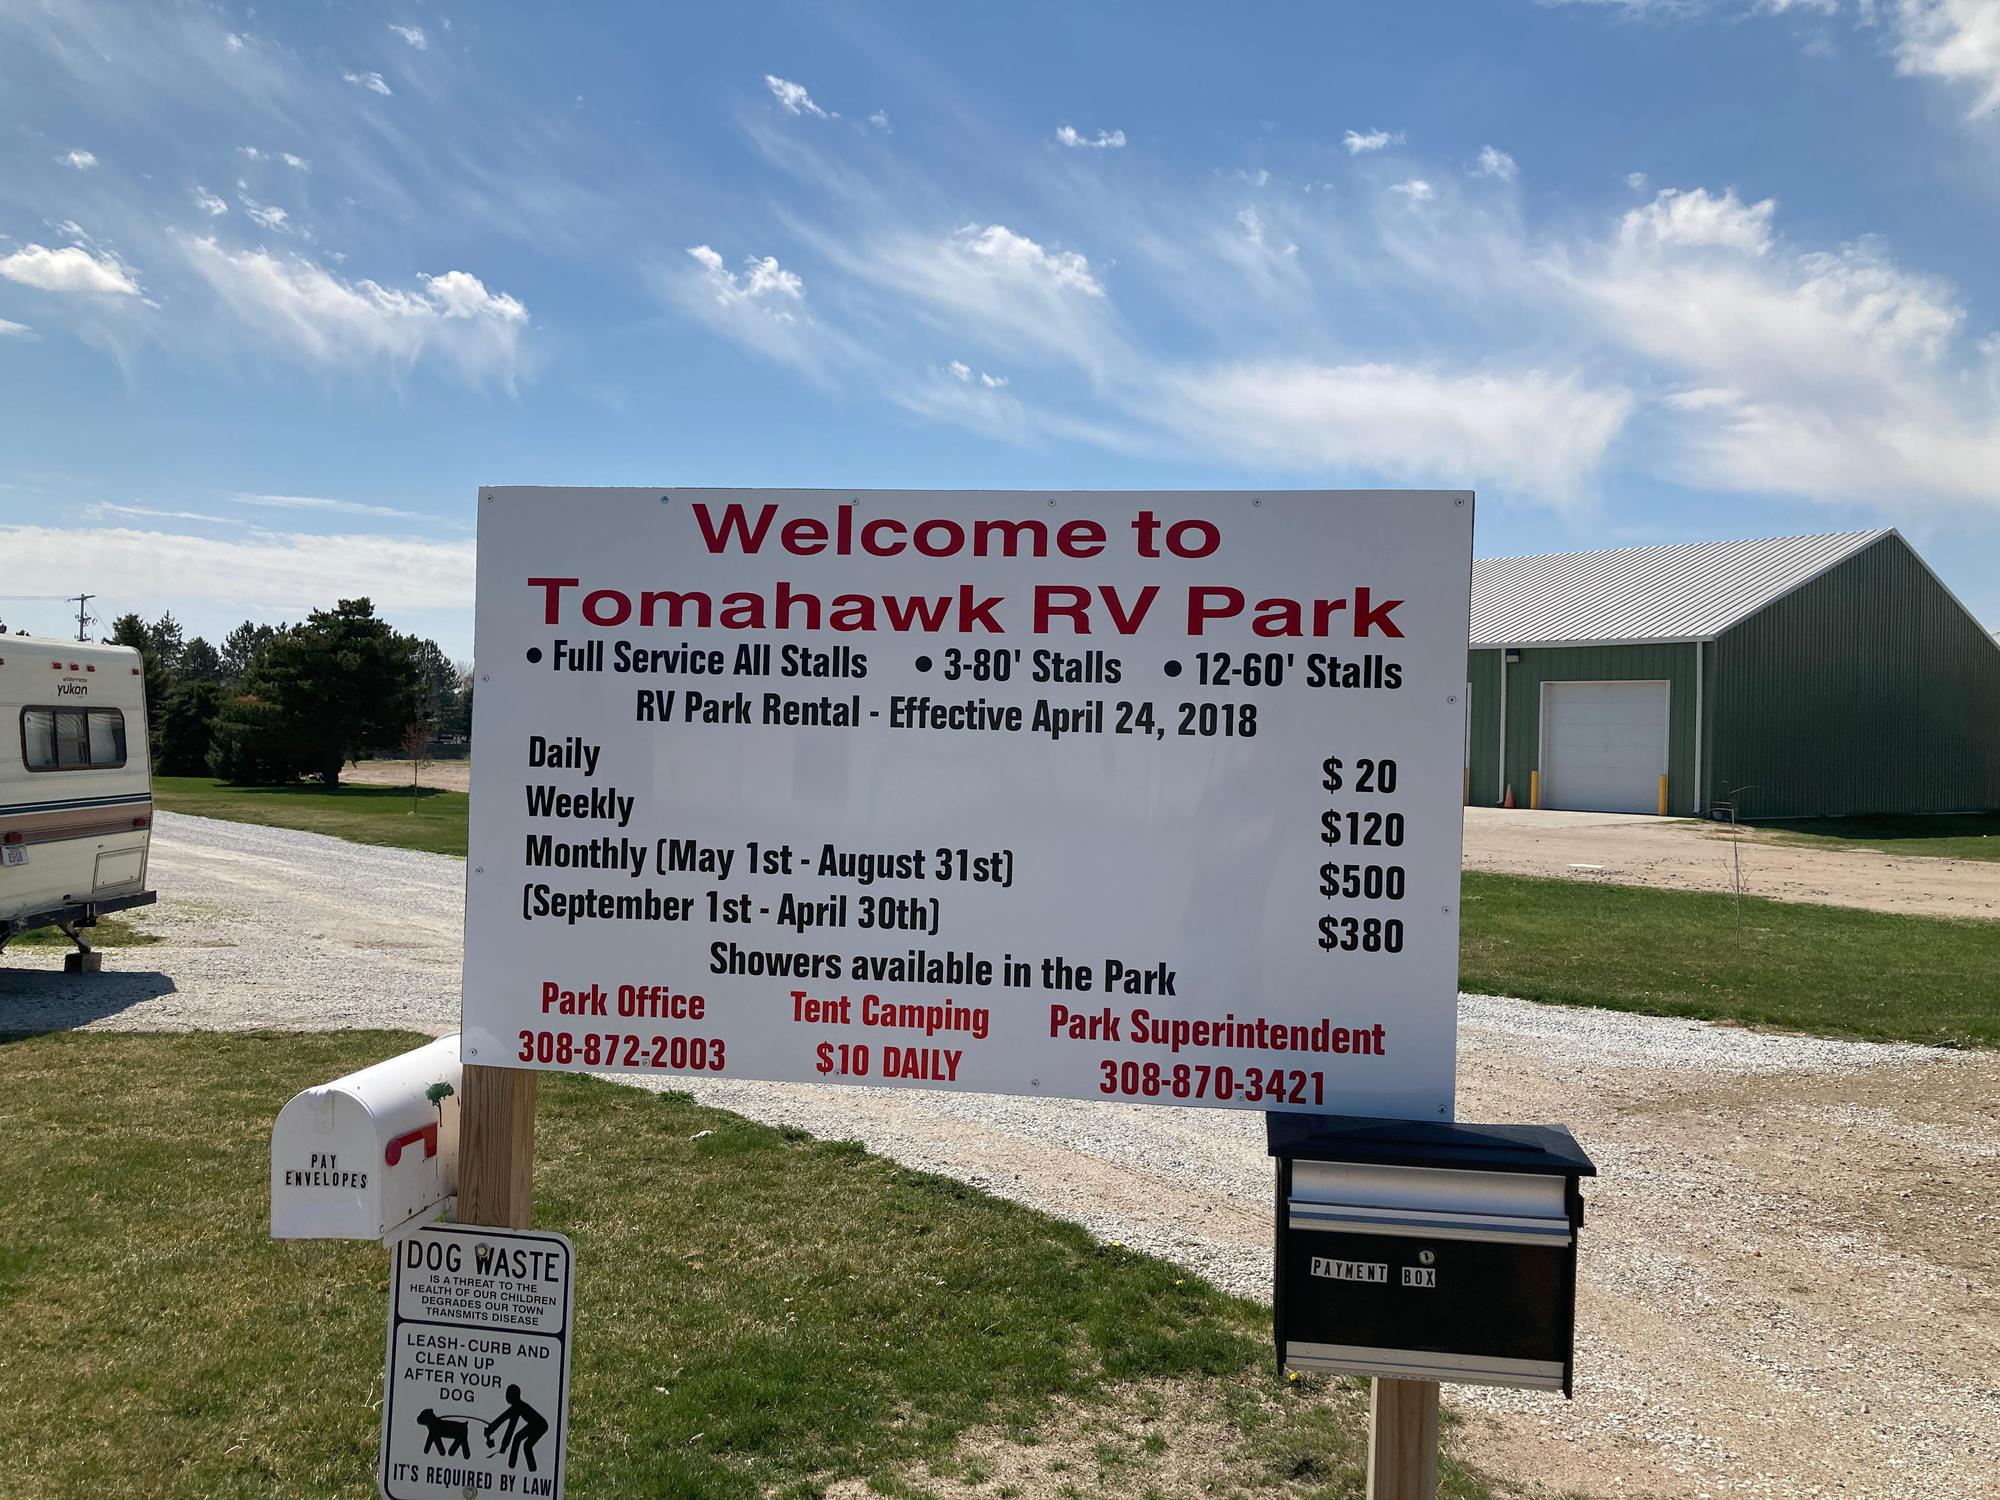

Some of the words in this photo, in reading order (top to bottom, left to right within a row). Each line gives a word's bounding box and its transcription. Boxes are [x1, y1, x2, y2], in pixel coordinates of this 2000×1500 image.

[692, 504, 1106, 558] Welcome
[1132, 511, 1220, 558] to
[528, 578, 1005, 633] Tomahawk
[1034, 586, 1160, 634] RV
[1188, 587, 1405, 638] Park
[554, 640, 603, 671] Full
[614, 641, 724, 674] Service
[733, 644, 770, 675] All
[781, 644, 867, 678] Stalls
[945, 648, 1020, 681] 3-80'
[1033, 649, 1121, 683] Stalls
[1196, 653, 1294, 686] 12-60'
[1307, 654, 1402, 689] Stalls
[58, 683, 88, 696] yukon
[637, 690, 675, 721] RV
[685, 691, 751, 724] Park
[763, 693, 859, 726] Rental
[890, 696, 1022, 731] Effective
[1032, 700, 1103, 740] April
[1116, 701, 1164, 740] 24,
[1178, 703, 1257, 737] 2018
[529, 736, 600, 776] Daily
[1356, 759, 1396, 793] 20
[526, 785, 634, 827] Weekly
[1321, 809, 1404, 847] $120
[526, 835, 647, 877] Monthly
[657, 839, 734, 880] (May
[747, 842, 792, 874] 1st
[818, 844, 925, 885] August
[936, 848, 1013, 887] 31st)
[1320, 862, 1404, 900] $500
[523, 884, 694, 925] (September
[706, 891, 751, 923] 1st
[777, 893, 846, 933] April
[858, 896, 939, 935] 30th)
[1319, 914, 1403, 953] $380
[710, 942, 841, 979] Showers
[852, 950, 992, 985] available
[1004, 954, 1031, 987] in
[1042, 957, 1092, 991] the
[1105, 960, 1176, 996] Park
[542, 982, 607, 1016] Park
[618, 985, 704, 1020] Office
[791, 991, 850, 1024] Tent
[863, 995, 989, 1039] Camping
[1051, 1005, 1120, 1041] Park
[1131, 1009, 1385, 1055] Superintendent
[519, 1030, 725, 1071] 308-872-2003
[816, 1041, 869, 1076] $10
[883, 1046, 962, 1081] DAILY
[1100, 1060, 1324, 1105] 308-870-3421
[285, 1171, 367, 1189] ENVELOPES
[311, 1154, 337, 1169] PAY
[407, 1240, 461, 1272] DOG
[475, 1243, 559, 1282] WASTE
[1313, 1259, 1386, 1280] PAYMENT
[1404, 1269, 1433, 1285] BOX
[410, 1284, 451, 1295] HEALTH
[455, 1288, 470, 1297] OF
[473, 1289, 497, 1300] OUR
[501, 1293, 556, 1306] CHILDREN
[429, 1275, 440, 1283] IS
[443, 1276, 450, 1284] A
[453, 1277, 495, 1288] THREAT
[499, 1281, 512, 1290] TO
[516, 1283, 537, 1293] THE
[422, 1296, 481, 1309] DEGRADES
[485, 1302, 508, 1311] OUR
[513, 1305, 544, 1316] TOWN
[426, 1307, 488, 1320] TRANSMITS
[492, 1314, 538, 1326] DISEASE
[415, 1352, 468, 1368] CLEAN
[474, 1357, 494, 1370] UP
[517, 1345, 550, 1358] AND
[404, 1367, 454, 1383] AFTER
[460, 1373, 501, 1388] YOUR
[440, 1388, 475, 1402] DOG
[393, 1463, 418, 1482] IT'S
[427, 1466, 492, 1489] REQUIRED
[500, 1474, 516, 1492] BY
[523, 1477, 552, 1496] LAW
